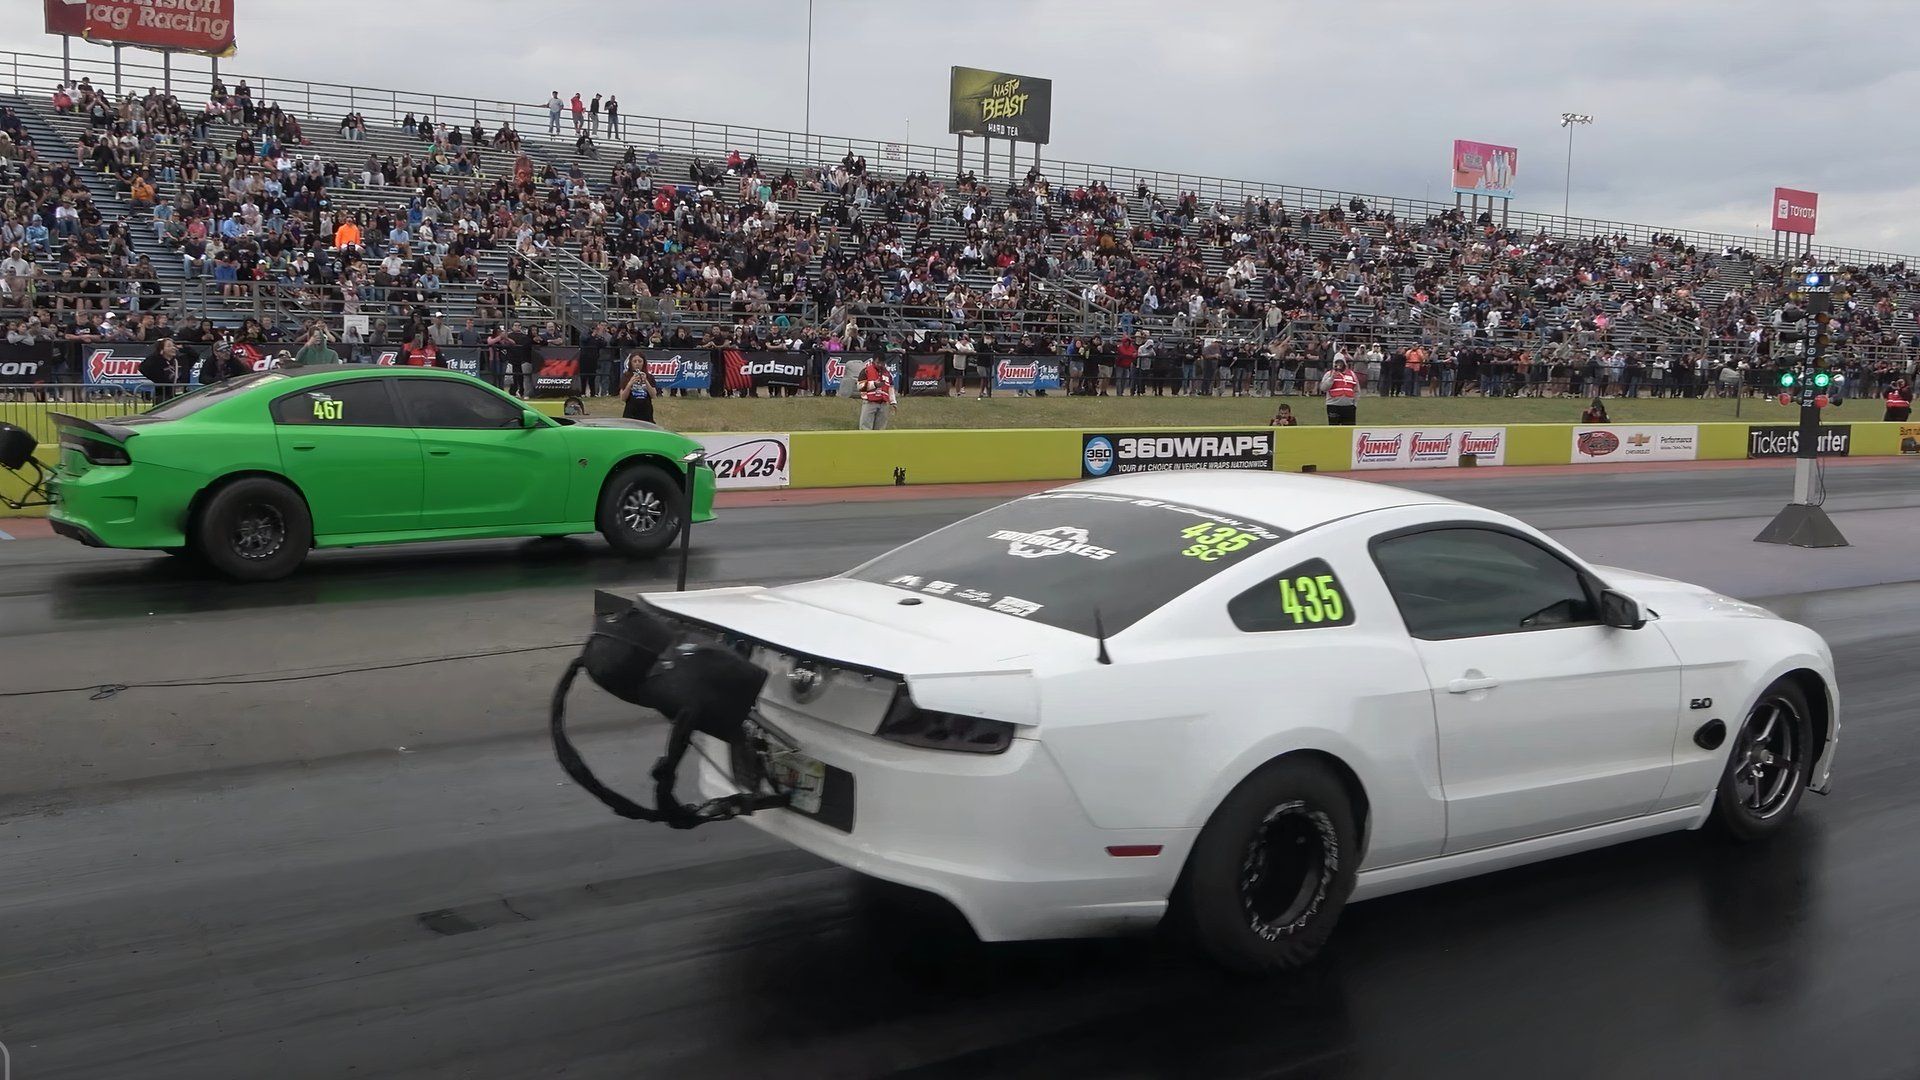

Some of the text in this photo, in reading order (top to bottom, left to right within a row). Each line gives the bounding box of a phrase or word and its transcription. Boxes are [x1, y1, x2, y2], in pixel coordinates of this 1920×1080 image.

[86, 3, 132, 30] rag
[137, 6, 230, 40] Racing
[981, 93, 1028, 122] BEAST
[988, 123, 1019, 136] HARD TEA
[1790, 205, 1815, 218] TOYOTA
[1791, 265, 1840, 273] PRE-STAGE
[740, 360, 804, 376] dodson
[997, 360, 1038, 386] SUMMIT
[313, 400, 344, 420] 467
[1118, 435, 1269, 459] 360WRAPS
[1357, 431, 1500, 463] SUMMIT SUMMIT SUMMIT
[1751, 430, 1847, 454] TicketSrter
[1086, 449, 1112, 458] 360
[1118, 464, 1136, 472] YOUR
[1148, 463, 1173, 471] CHOICE
[1182, 462, 1207, 470] VEHICLE
[1208, 461, 1230, 469] WRAPS
[1231, 460, 1268, 468] NATIONWIDE
[1180, 522, 1260, 552] 435
[1181, 544, 1226, 561] SC
[1279, 575, 1344, 623] 435
